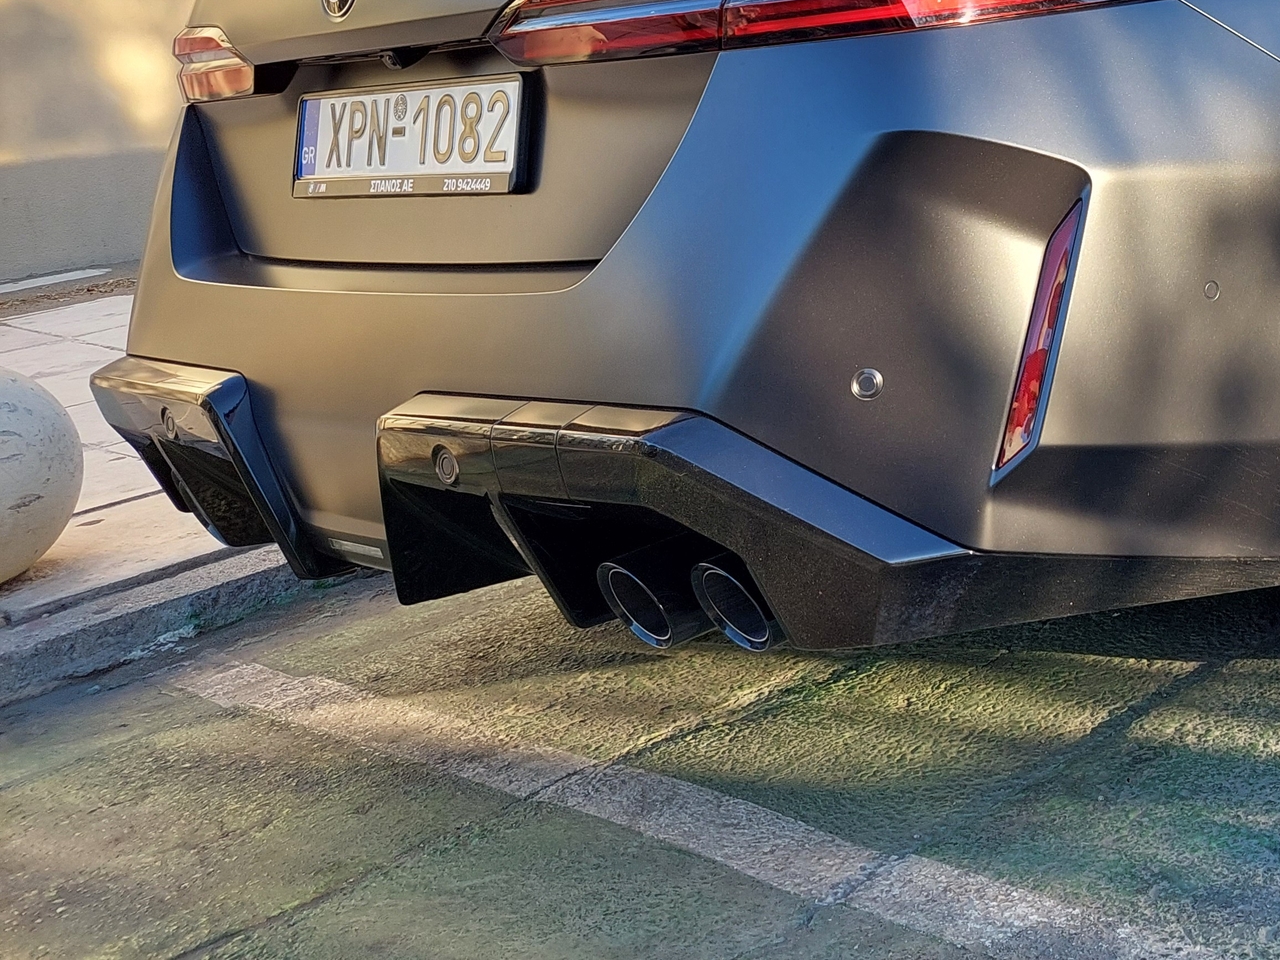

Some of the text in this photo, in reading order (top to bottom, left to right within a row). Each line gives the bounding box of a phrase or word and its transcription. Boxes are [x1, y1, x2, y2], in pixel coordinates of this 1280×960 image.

[301, 146, 315, 165] GR
[370, 180, 402, 192] ΣΠΑΝΟΣ
[443, 178, 491, 191] 210 9424449
